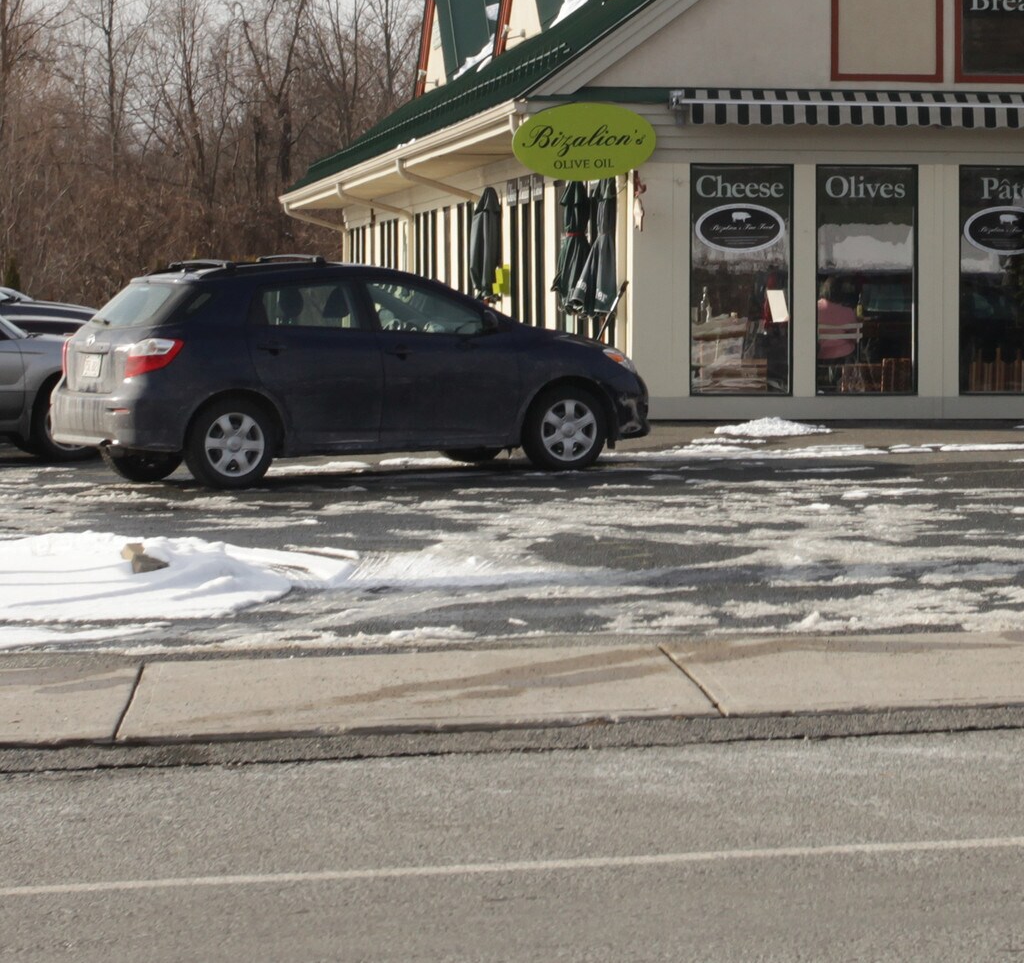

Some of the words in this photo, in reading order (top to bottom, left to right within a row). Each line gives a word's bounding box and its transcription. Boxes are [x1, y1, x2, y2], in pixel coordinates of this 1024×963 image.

[521, 124, 647, 157] Bizalion's
[553, 158, 590, 170] OLIVE
[593, 157, 614, 169] OIL
[695, 174, 784, 198] Cheese
[825, 175, 906, 198] Olives
